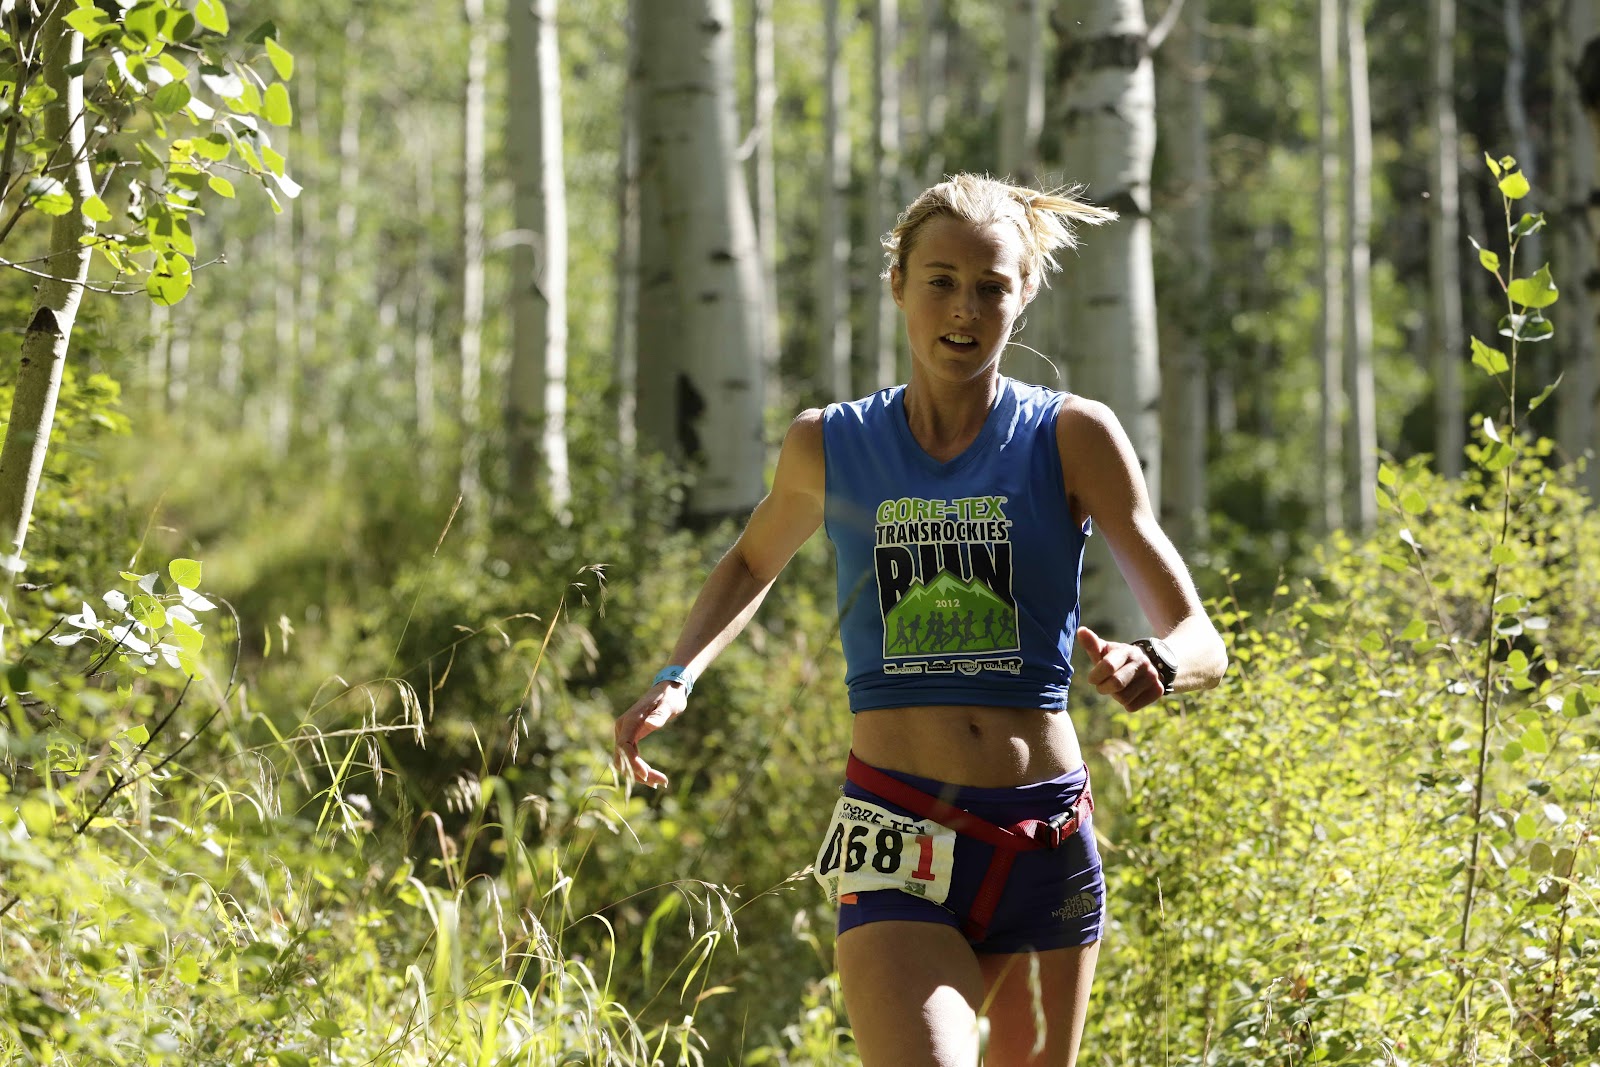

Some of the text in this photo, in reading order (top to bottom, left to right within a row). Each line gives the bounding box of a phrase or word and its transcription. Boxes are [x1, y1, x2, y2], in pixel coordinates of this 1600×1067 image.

[877, 498, 1006, 522] GORE-TEX
[875, 520, 1008, 545] TRANSROCKIES
[875, 542, 1016, 618] RUN
[935, 598, 960, 608] 2012
[819, 822, 936, 881] 0681
[1051, 901, 1083, 918] NORTH
[1063, 894, 1081, 906] THE
[1061, 907, 1084, 921] FACE
